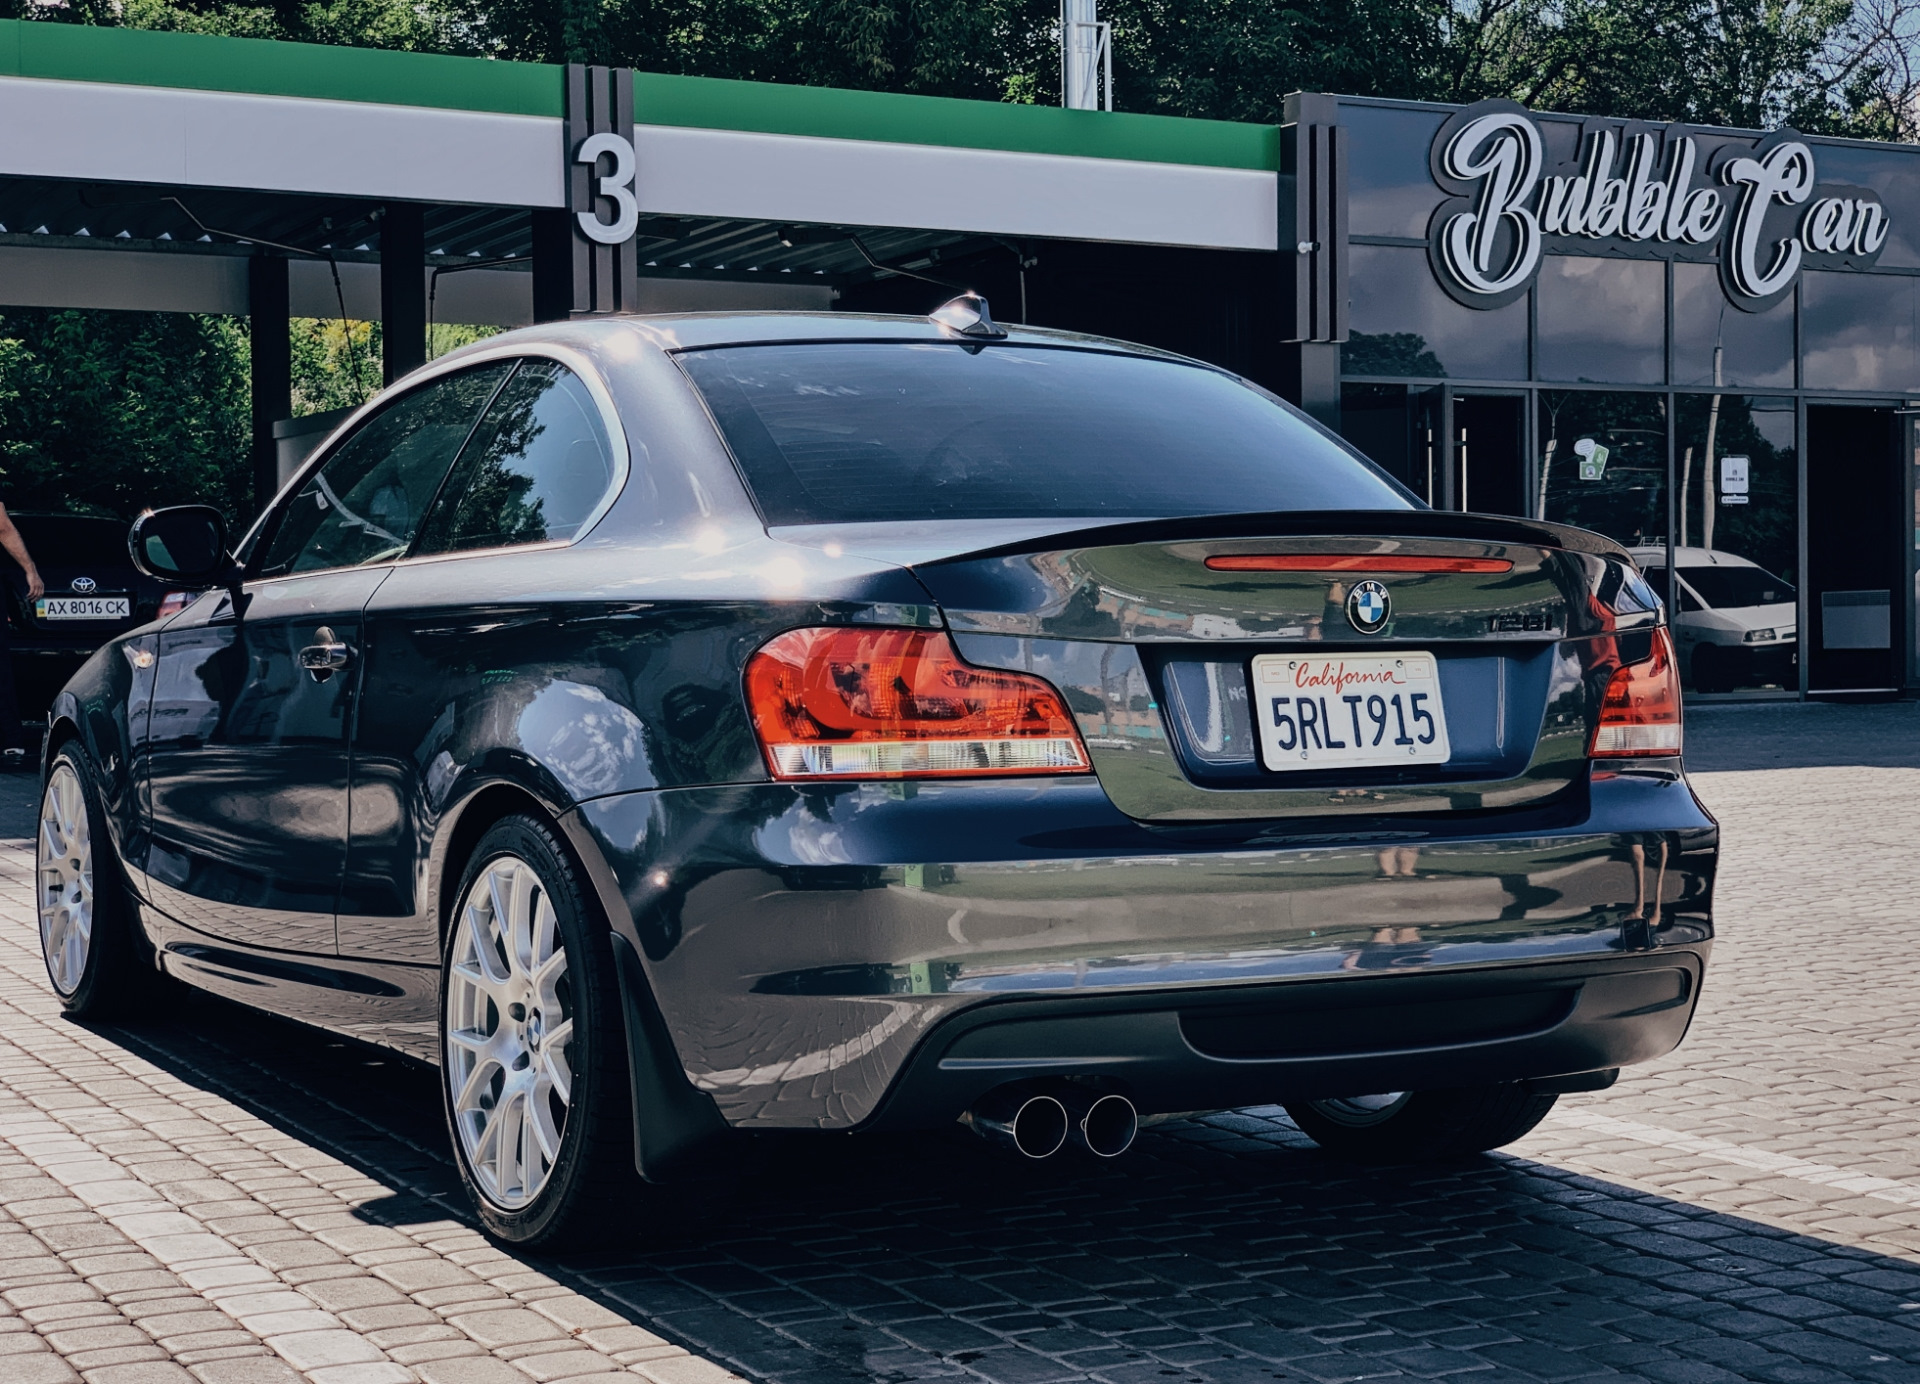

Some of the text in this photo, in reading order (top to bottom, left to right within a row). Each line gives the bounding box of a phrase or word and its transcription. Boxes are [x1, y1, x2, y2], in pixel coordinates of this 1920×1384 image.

[576, 132, 639, 245] 3
[1443, 113, 1890, 297] Bubble Car
[47, 601, 68, 615] AX
[70, 600, 103, 614] 8016
[105, 600, 127, 614] CK
[1353, 582, 1389, 600] BMW
[1294, 661, 1407, 695] California
[1271, 692, 1437, 751] 5RLT915
